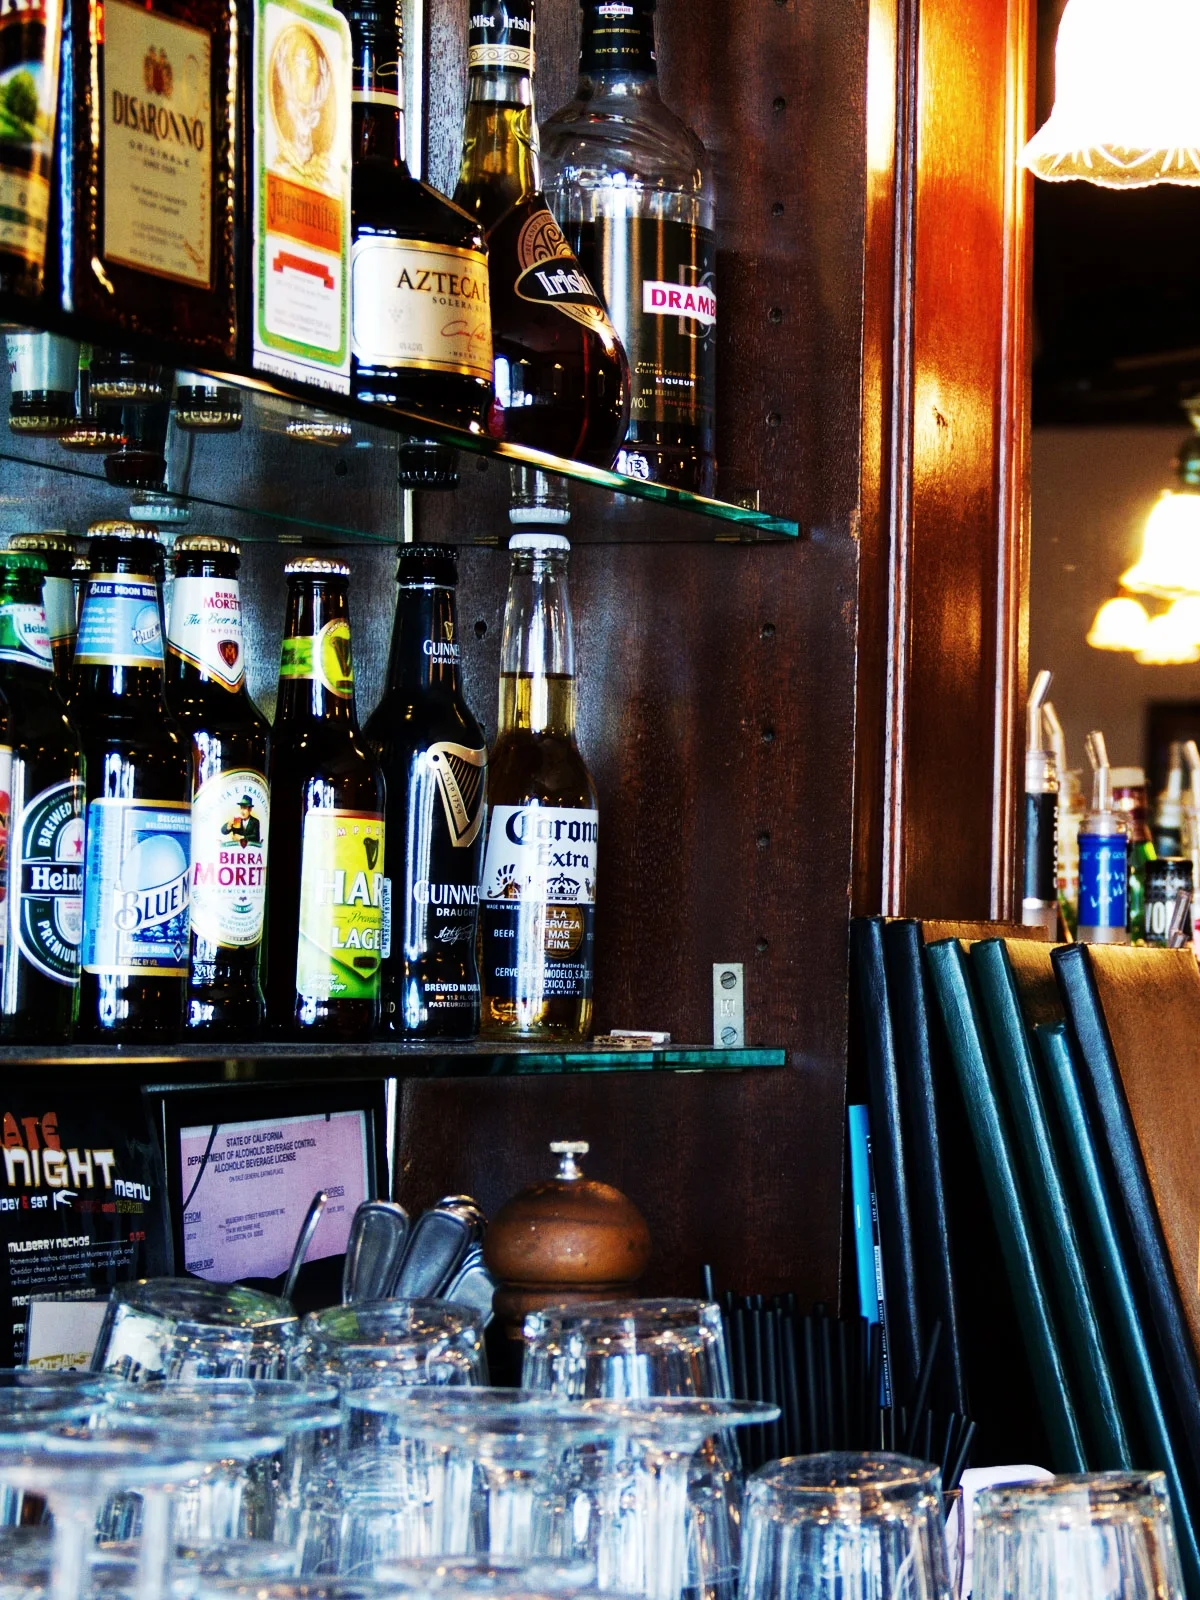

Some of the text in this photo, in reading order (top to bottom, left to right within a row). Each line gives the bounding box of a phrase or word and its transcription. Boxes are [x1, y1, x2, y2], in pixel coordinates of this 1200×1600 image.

[472, 14, 530, 31] Mist Irish
[112, 89, 204, 152] DISARONNO
[397, 267, 480, 299] AZTECA
[535, 268, 594, 297] Irish
[432, 296, 472, 311] SOLERA
[635, 367, 663, 376] Charles
[655, 377, 695, 387] LIQUEUR
[90, 582, 112, 595] BLUE
[114, 585, 141, 596] MOON
[215, 591, 237, 600] BIRRA
[183, 613, 201, 627] The
[38, 801, 72, 848] BREWED
[219, 851, 263, 865] BIRRA
[537, 844, 589, 868] Extra
[115, 884, 179, 931] BLUE
[436, 907, 476, 917] DRAUGHT
[553, 909, 567, 919] LA
[535, 919, 580, 930] CERVEZA
[493, 929, 515, 938] BEER
[548, 930, 570, 939] MAS
[547, 940, 570, 950] FINA
[544, 969, 575, 980] MODELO,
[424, 983, 467, 992] BREWED IN
[566, 980, 577, 989] D.F.
[0, 1111, 62, 1153] ATE
[226, 1131, 284, 1148] STATE OF CALIFORNIA
[226, 1150, 234, 1160] OF
[235, 1145, 266, 1159] ALCOHOLIC
[266, 1141, 294, 1155] BEVERAGE
[294, 1138, 317, 1150] CONTROL
[214, 1151, 297, 1174] ALCOHOLIC BEVERAGE LICENSE
[324, 1185, 345, 1196] EXPIRES
[184, 1211, 202, 1222] FROM
[59, 1253, 80, 1261] covered
[10, 1267, 32, 1276] Cheddar
[56, 1263, 67, 1271] with
[30, 1275, 47, 1284] beans
[47, 1274, 58, 1282] and
[58, 1273, 69, 1281] sour
